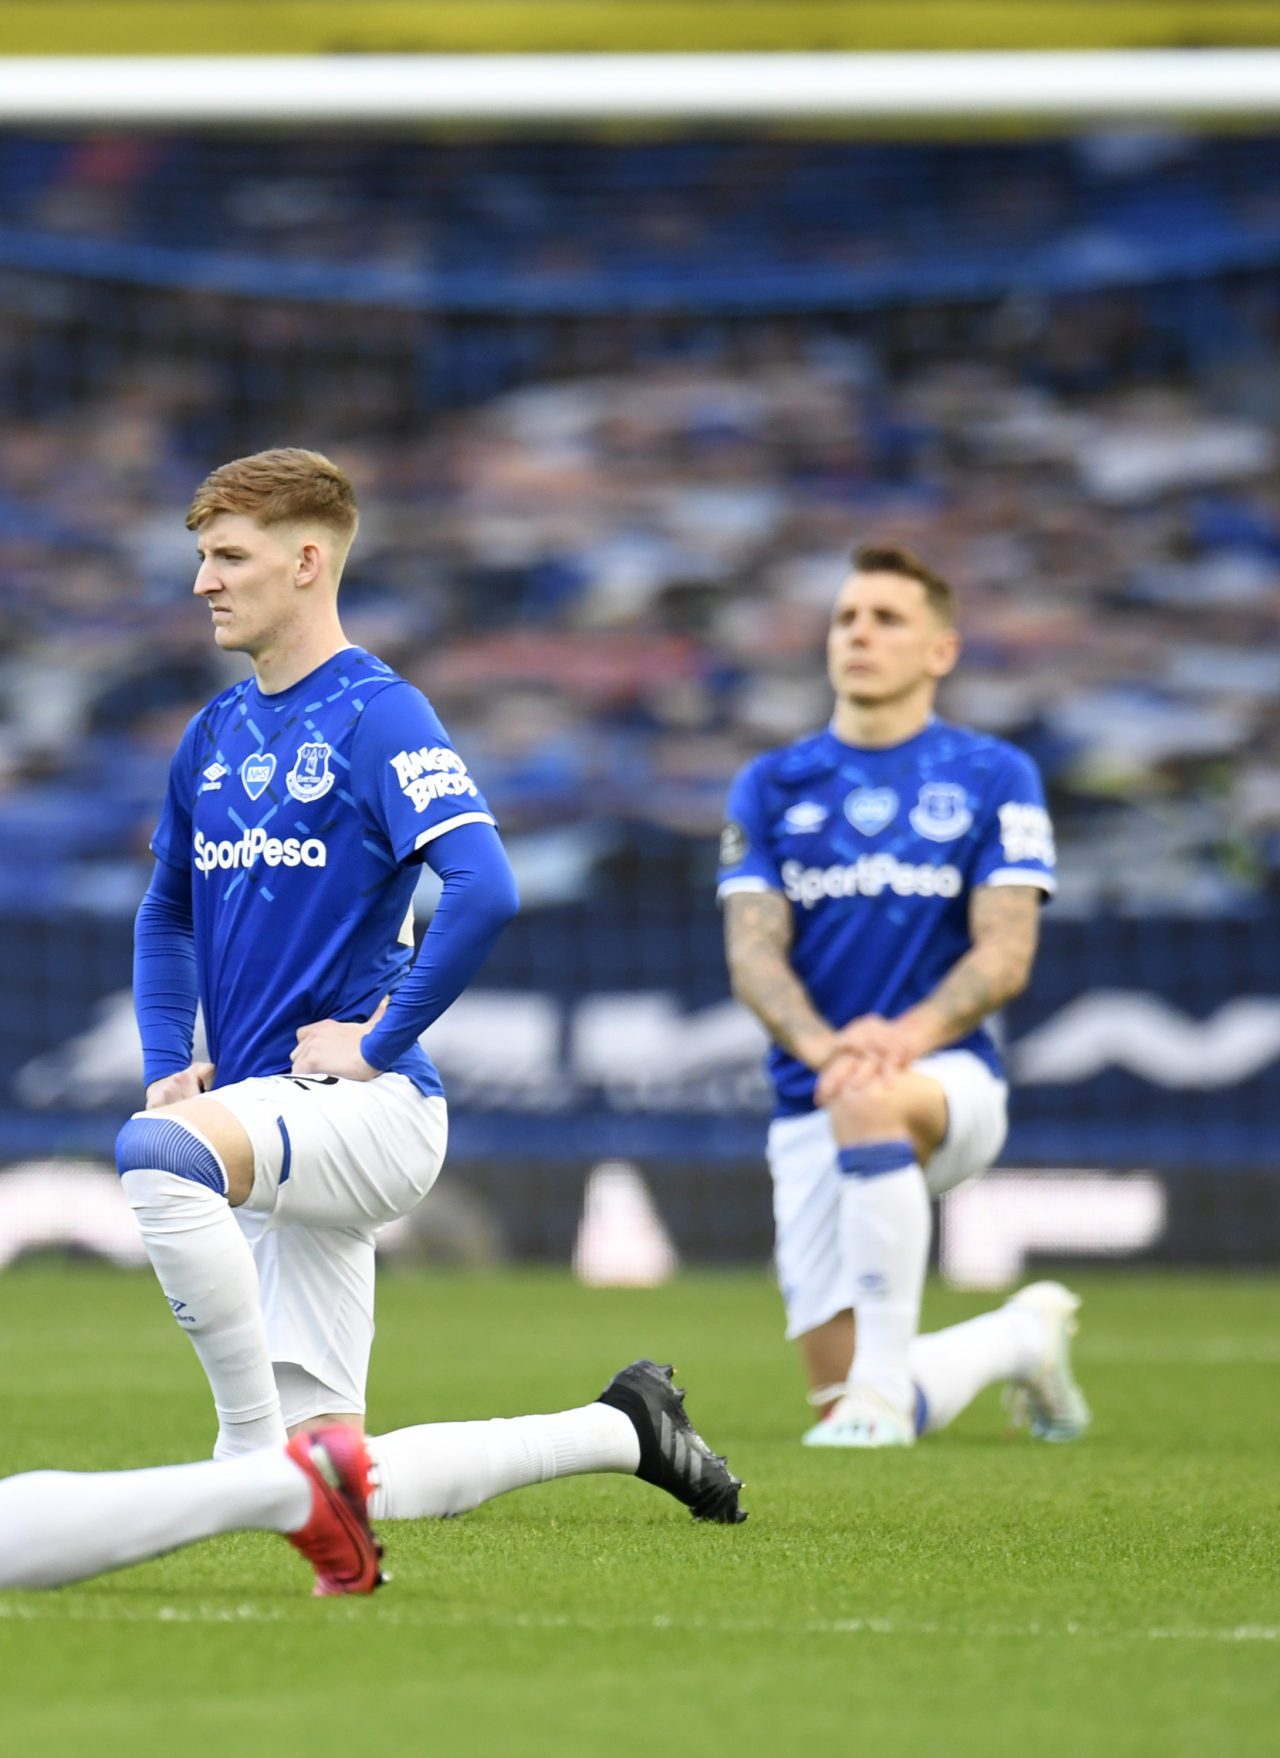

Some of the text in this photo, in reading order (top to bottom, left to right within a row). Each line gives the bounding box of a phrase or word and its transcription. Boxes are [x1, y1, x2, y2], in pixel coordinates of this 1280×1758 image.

[249, 768, 269, 781] NHS
[389, 747, 468, 789] ANGRY
[402, 772, 478, 814] BIRDS
[194, 828, 326, 880] SportPesa
[781, 852, 962, 910] SportPesa
